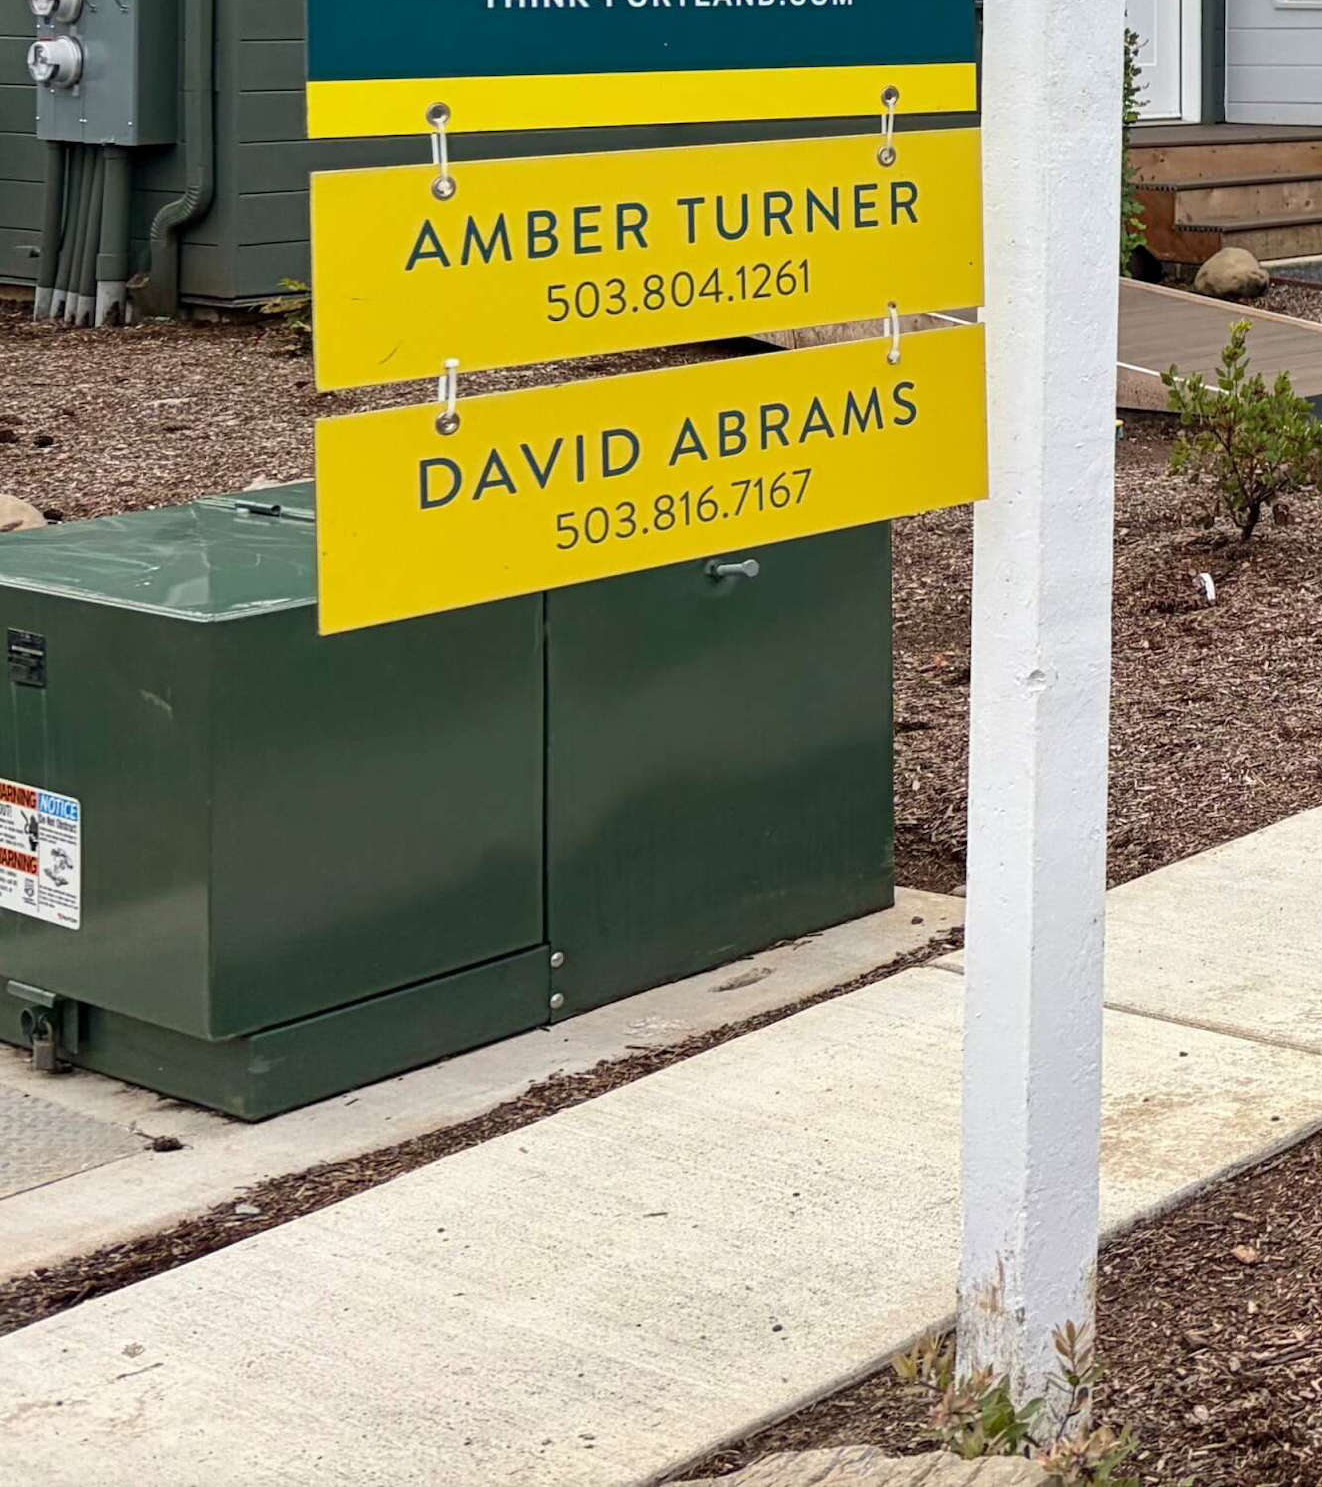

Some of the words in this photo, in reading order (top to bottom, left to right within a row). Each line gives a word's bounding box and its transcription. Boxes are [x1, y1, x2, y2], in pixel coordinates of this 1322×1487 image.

[404, 201, 650, 272] AMBER
[677, 180, 920, 245] TURNER
[546, 258, 812, 323] 503.804.1261
[418, 428, 641, 511] DAVID
[668, 380, 918, 467] ABRAMS
[555, 468, 813, 551] 503.816.7167
[0, 782, 36, 808] ARNING
[40, 793, 78, 821] NOTICE
